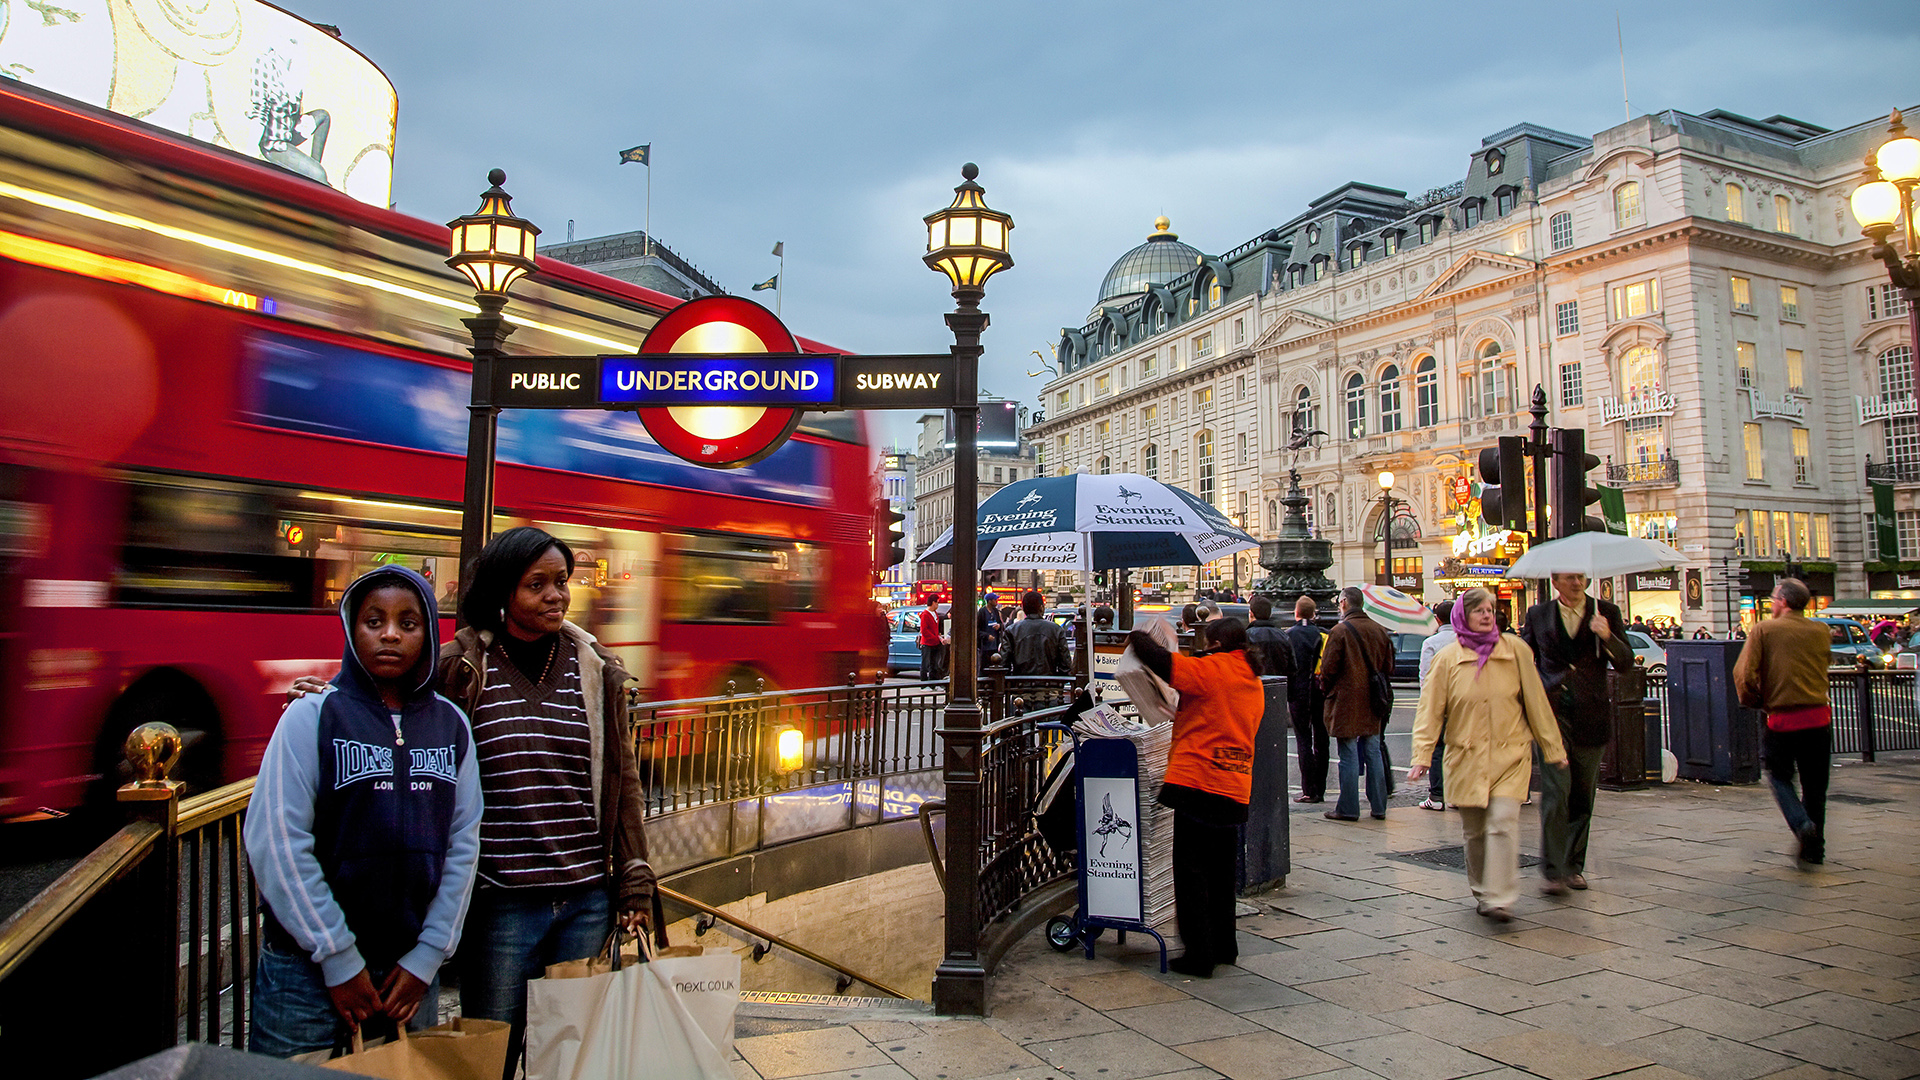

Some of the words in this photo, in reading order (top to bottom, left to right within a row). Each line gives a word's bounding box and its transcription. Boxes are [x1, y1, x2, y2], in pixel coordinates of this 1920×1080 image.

[511, 372, 581, 391] PUBLIC
[616, 369, 820, 392] UNDERGROUND
[856, 372, 942, 391] SUBWAY
[981, 508, 1057, 525] Evening
[1094, 504, 1175, 517] Evening
[977, 516, 1057, 536] Standard
[1095, 514, 1186, 526] Standard
[1090, 858, 1133, 870] Evening
[1086, 867, 1137, 879] Standard
